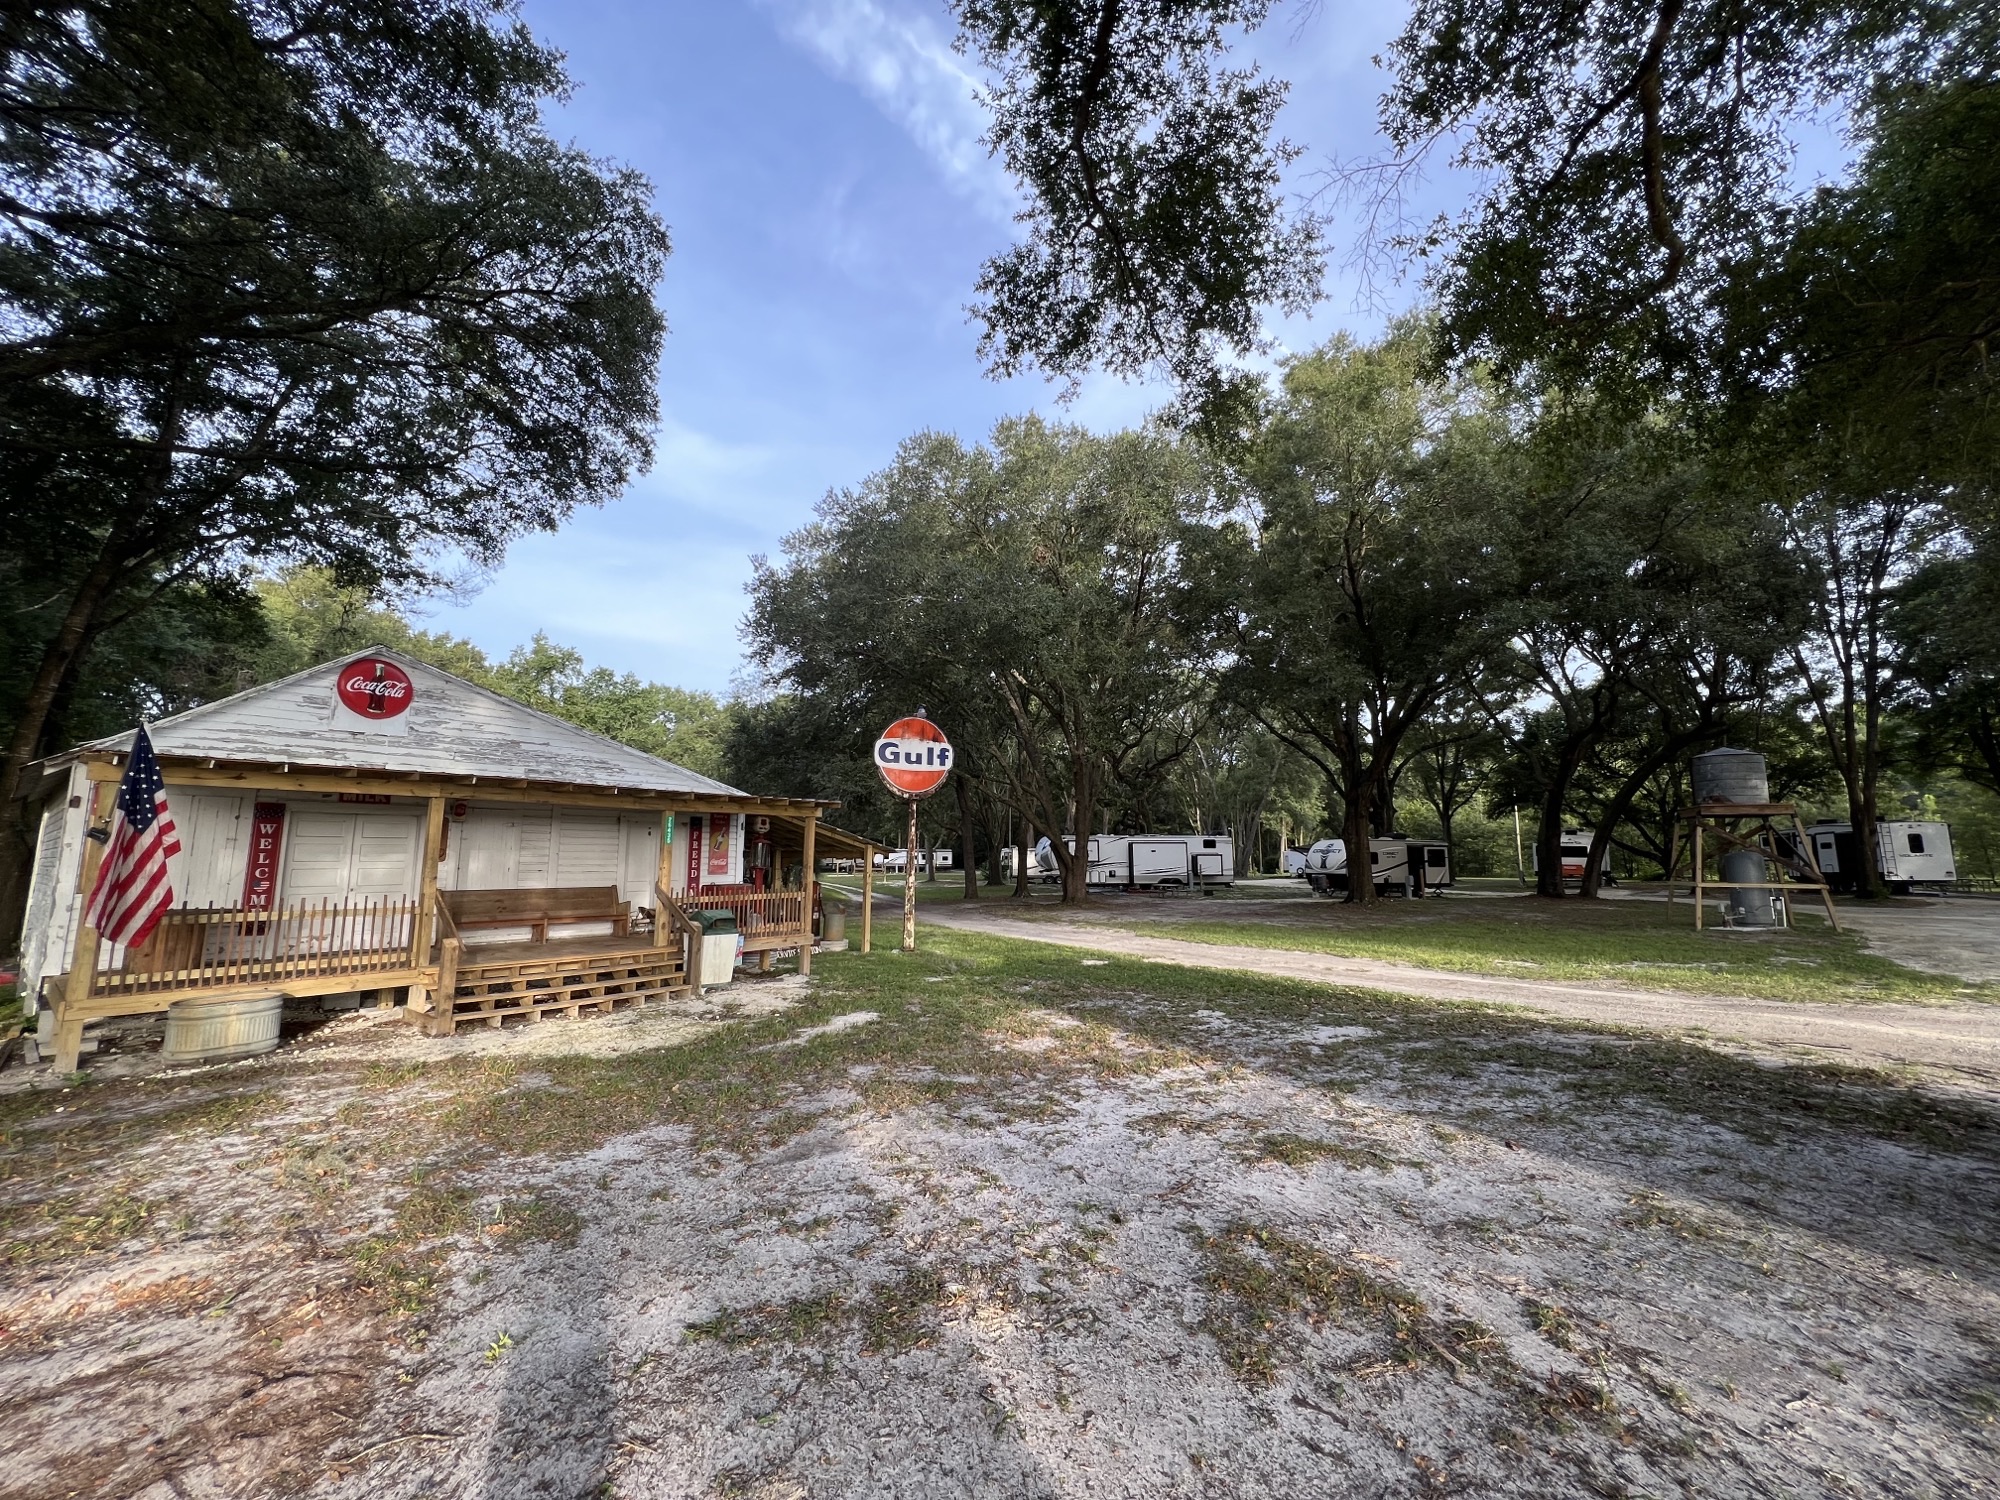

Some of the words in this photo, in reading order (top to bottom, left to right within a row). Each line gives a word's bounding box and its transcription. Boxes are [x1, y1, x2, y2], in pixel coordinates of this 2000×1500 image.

[346, 676, 409, 698] Coca-Cola
[878, 742, 950, 767] Gulf
[344, 794, 388, 803] MILK
[249, 823, 277, 912] WELCM
